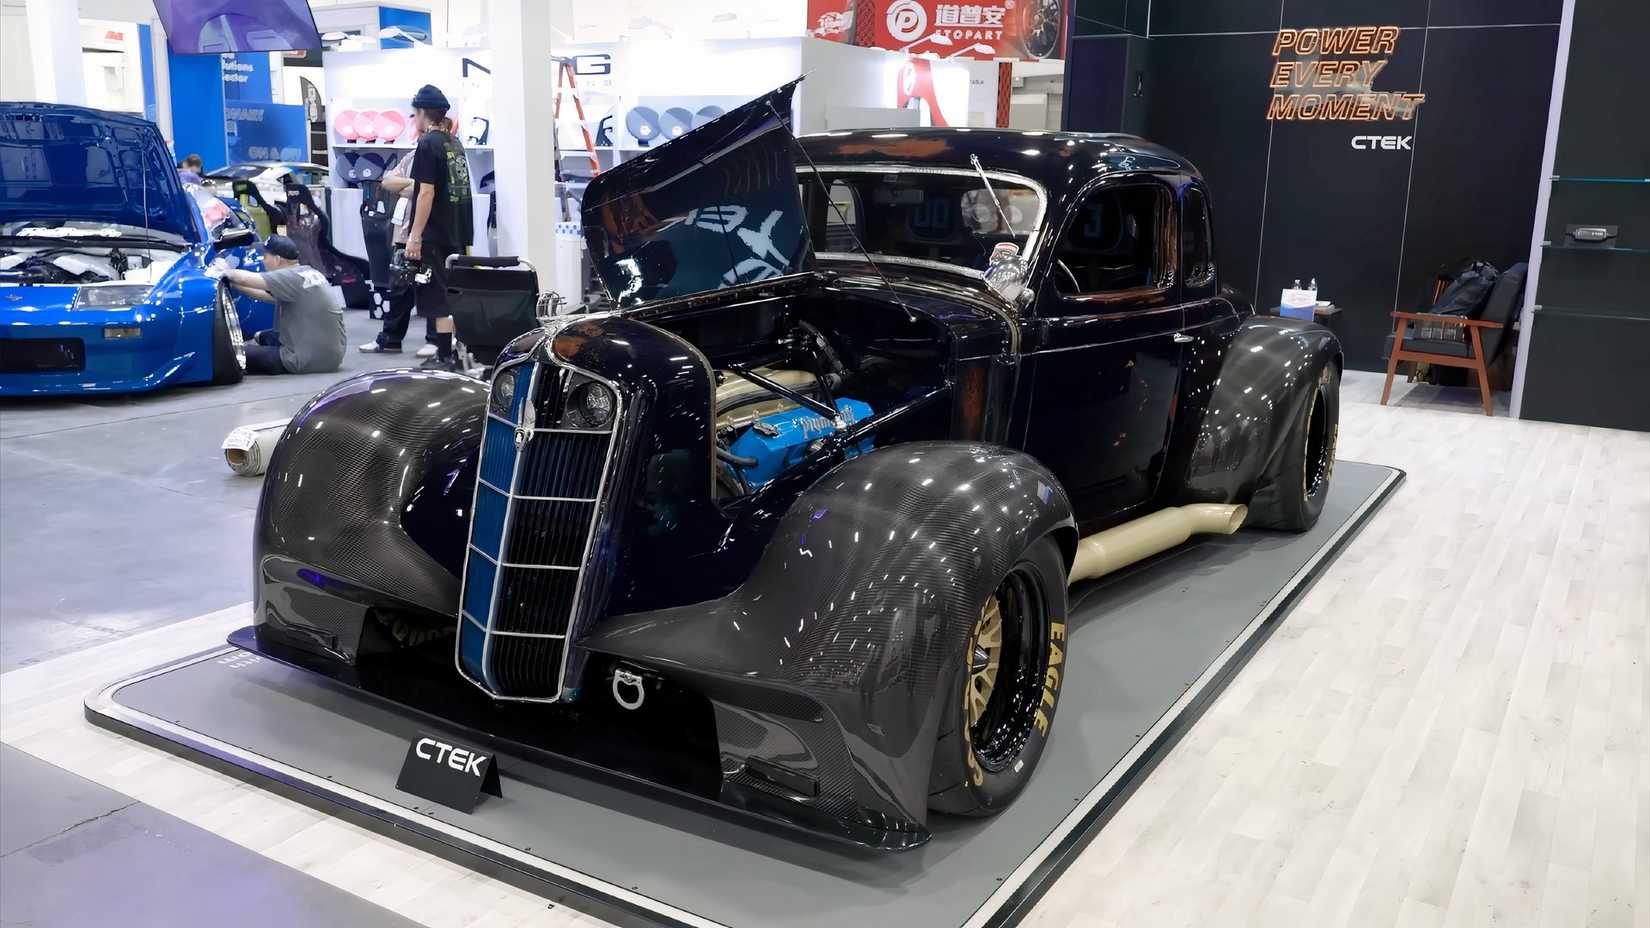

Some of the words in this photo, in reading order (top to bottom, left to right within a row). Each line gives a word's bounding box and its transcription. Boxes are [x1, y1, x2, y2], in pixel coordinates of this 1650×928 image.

[935, 4, 1006, 27] 道普安
[936, 30, 1003, 40] TOPART
[1272, 26, 1399, 56] POWER
[1269, 59, 1388, 88] EVERY
[1266, 92, 1426, 121] MOMENT
[1351, 135, 1412, 150] CTEK
[801, 405, 854, 439] Plymuth
[1033, 622, 1066, 737] EAGLE
[416, 737, 488, 777] CTEK
